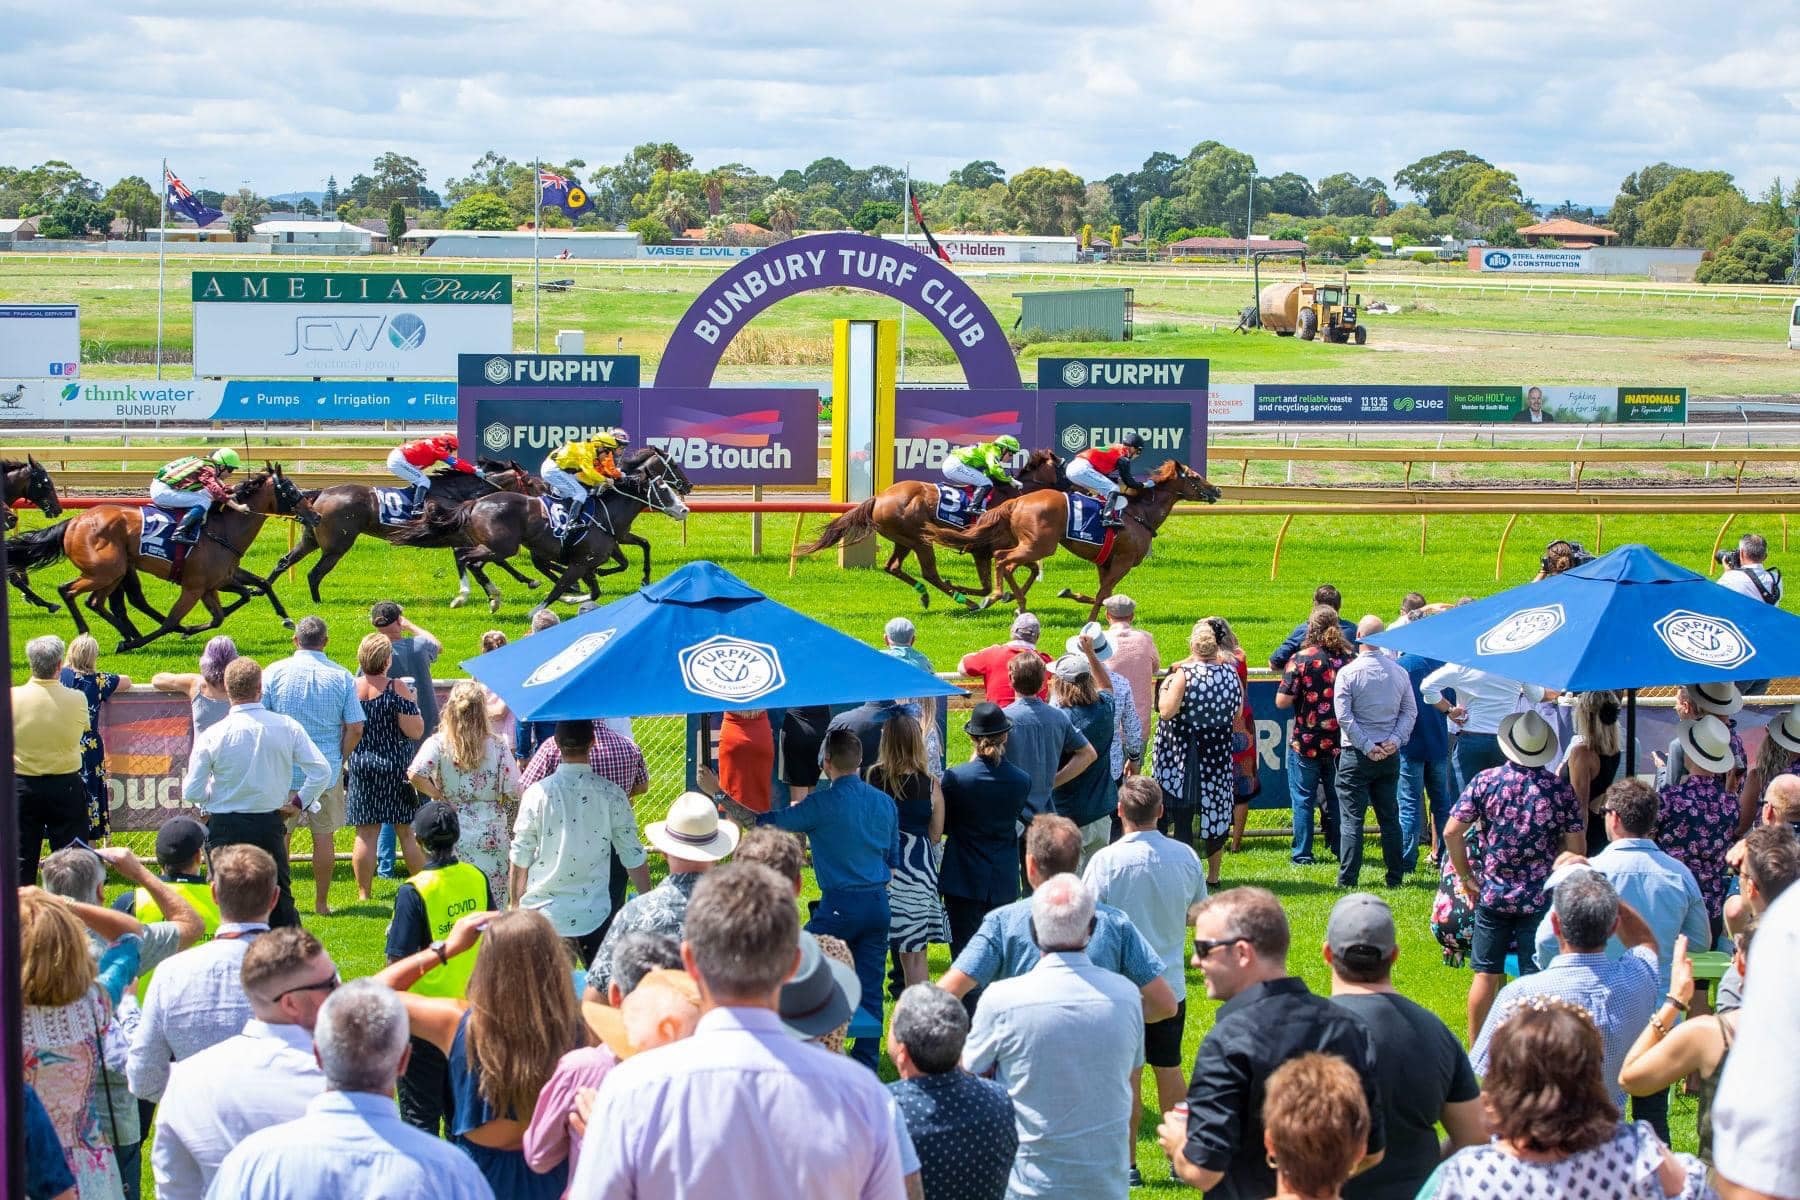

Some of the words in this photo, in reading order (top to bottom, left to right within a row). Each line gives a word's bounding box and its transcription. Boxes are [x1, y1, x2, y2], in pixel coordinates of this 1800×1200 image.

[645, 246, 694, 256] VASSE
[700, 246, 735, 257] CIVIL
[739, 247, 751, 257] &
[960, 242, 1006, 256] Holden
[1518, 260, 1580, 268] CONSTRUCTION
[202, 276, 409, 299] AMELIA
[421, 277, 504, 301] Park
[693, 249, 826, 345] BUNBURY
[838, 249, 918, 287] TURF
[921, 278, 985, 349] CLUB
[514, 360, 615, 382] FURPHY
[1091, 363, 1185, 385] FURPHY
[84, 384, 195, 401] thinkwater
[257, 393, 300, 406] Pumps
[424, 394, 456, 405] Filtra
[1258, 395, 1281, 403] smart
[1283, 395, 1298, 403] and
[1299, 395, 1329, 403] reliable
[1329, 395, 1353, 403] waste
[1467, 394, 1484, 403] Colin
[1485, 393, 1505, 403] HOLT
[1568, 391, 1597, 404] Fighting
[1628, 394, 1681, 404] NATIONALS
[333, 394, 391, 407] Irrigation
[1415, 399, 1444, 409] suez
[116, 404, 176, 416] BUNBURY
[1258, 403, 1273, 411] and
[1274, 403, 1309, 413] recycling
[1310, 403, 1343, 411] services
[646, 437, 792, 469] TABtouch
[940, 485, 961, 512] 3
[1072, 500, 1083, 531] 1
[140, 513, 169, 544] 2
[1672, 621, 1725, 637] FURPHY
[697, 648, 761, 668] FURPHY
[447, 898, 477, 917] COVID
